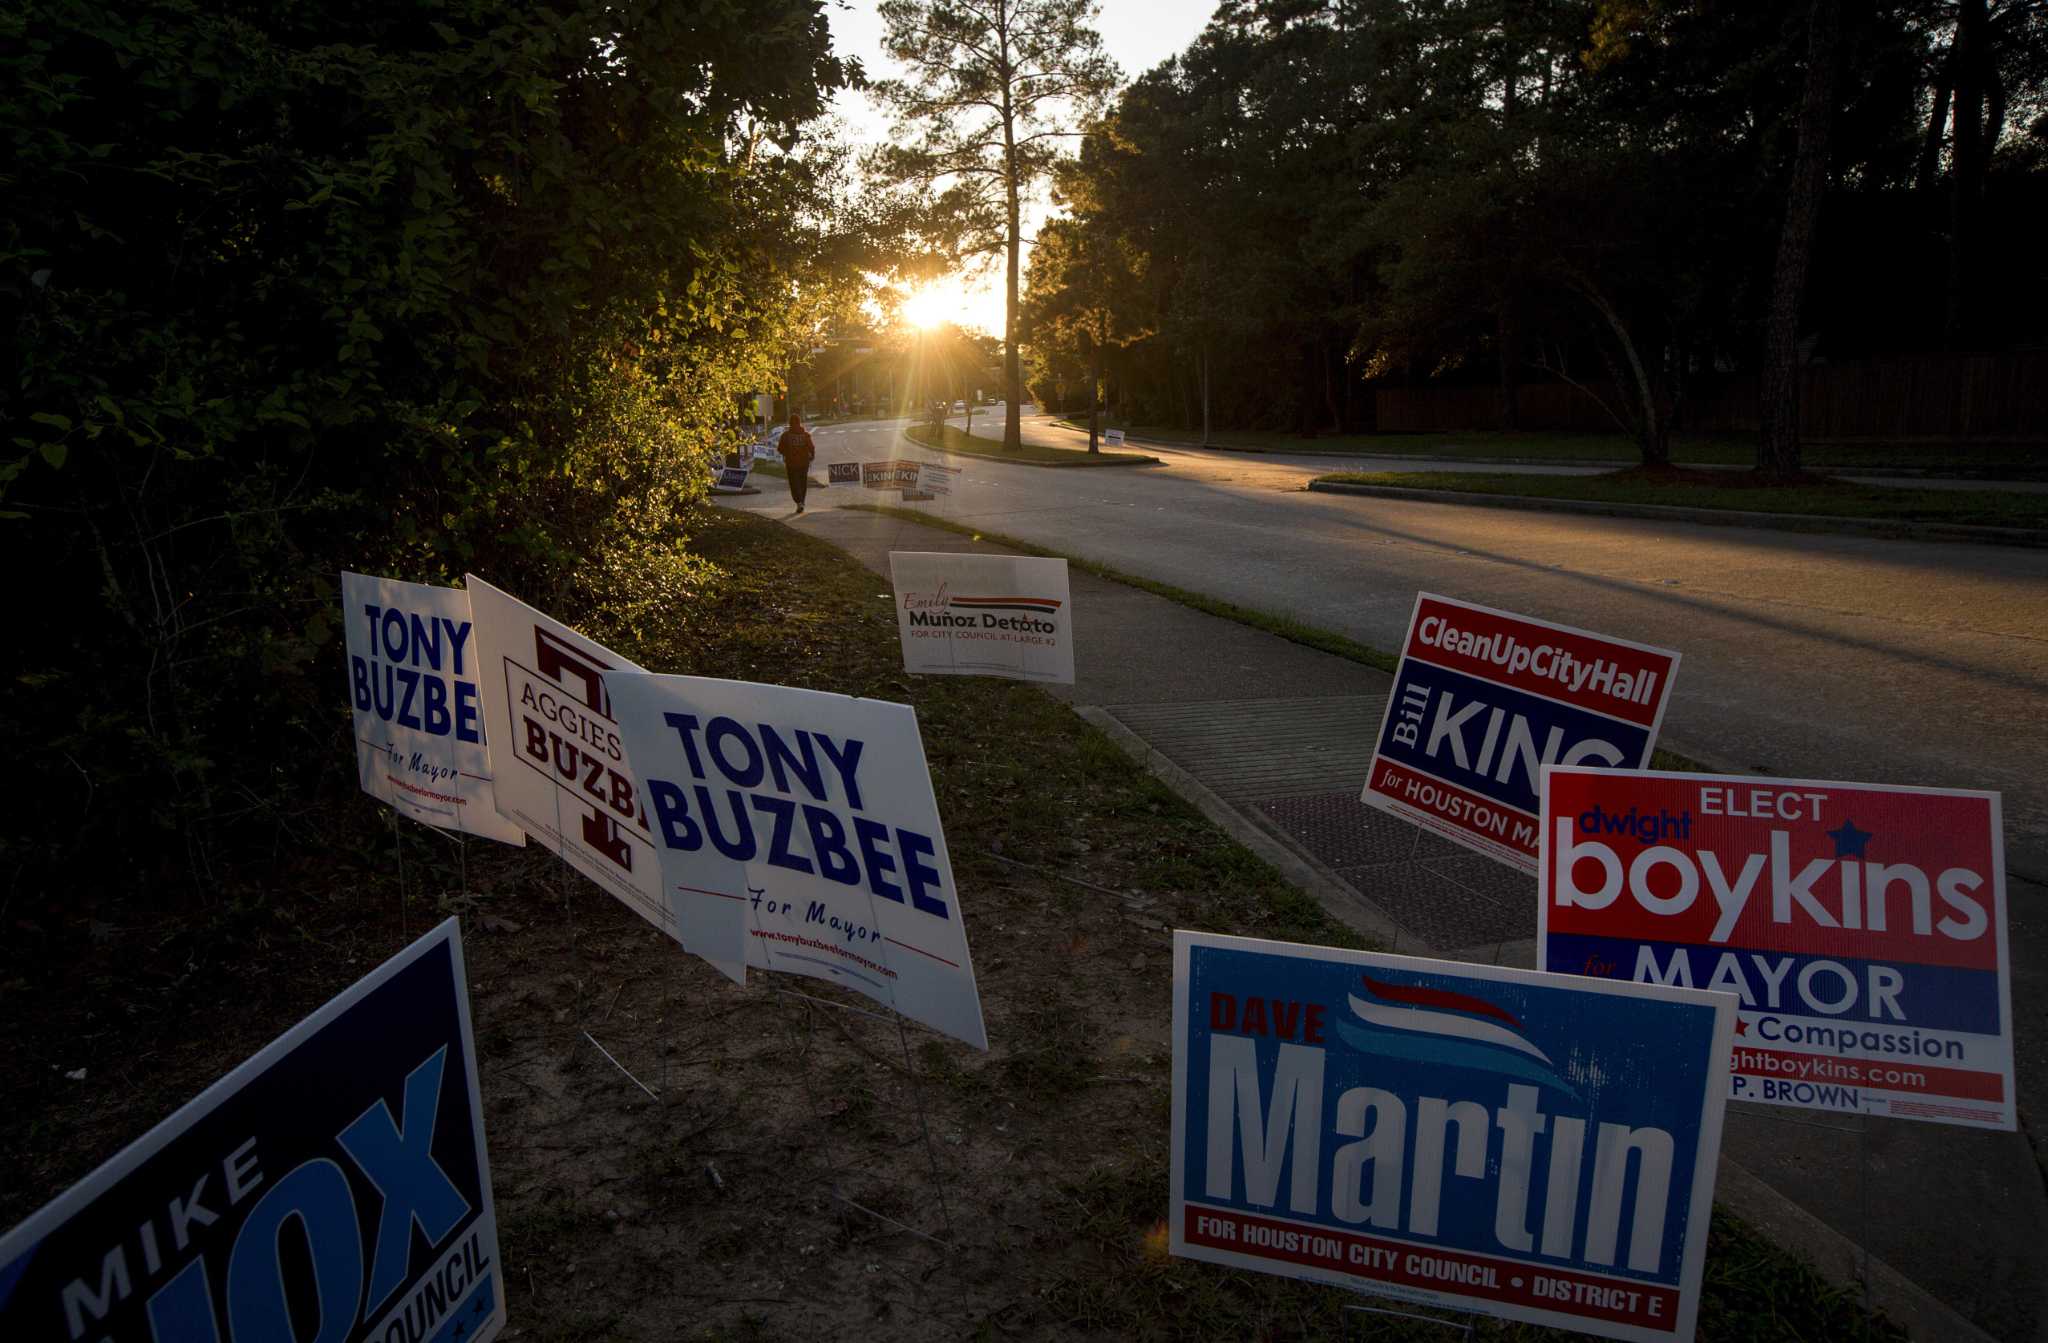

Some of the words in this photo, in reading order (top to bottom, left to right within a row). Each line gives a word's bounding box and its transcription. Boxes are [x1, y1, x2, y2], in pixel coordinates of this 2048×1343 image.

[365, 604, 472, 675] TONY
[909, 611, 977, 628] Muñoz
[911, 630, 930, 639] FOR
[931, 630, 952, 639] CITY
[956, 632, 997, 642] COUNCIL
[1419, 616, 1659, 705] CleanUpCityHall
[352, 655, 487, 747] BUZBE
[521, 683, 622, 761] AGGIES
[1392, 682, 1432, 750] Bill
[409, 752, 458, 783] Mayor
[523, 715, 650, 833] BUZB
[663, 712, 864, 811] TONY
[1379, 769, 1402, 789] for
[1405, 778, 1509, 837] HOUSTON
[1579, 804, 1691, 845] dwight
[1700, 786, 1828, 822] ELECT
[647, 779, 949, 920] BUZBEE
[1556, 816, 1989, 943] boykins
[748, 887, 792, 915] For
[806, 901, 881, 943] Mayor
[1210, 991, 1328, 1044] DAVE
[1632, 945, 1907, 1021] MAYOR
[1758, 1017, 1965, 1060] Compassion
[1763, 1079, 1858, 1109] BROWN
[1204, 1032, 1676, 1275] Martin
[61, 1135, 265, 1341] MIKE
[1197, 1215, 1238, 1239] FOR
[1243, 1223, 1343, 1261] HOUSTON
[1348, 1243, 1399, 1273] CITY
[1406, 1254, 1501, 1290] COUNCIL
[1532, 1276, 1642, 1314] DISTRICT
[1648, 1295, 1664, 1318] E
